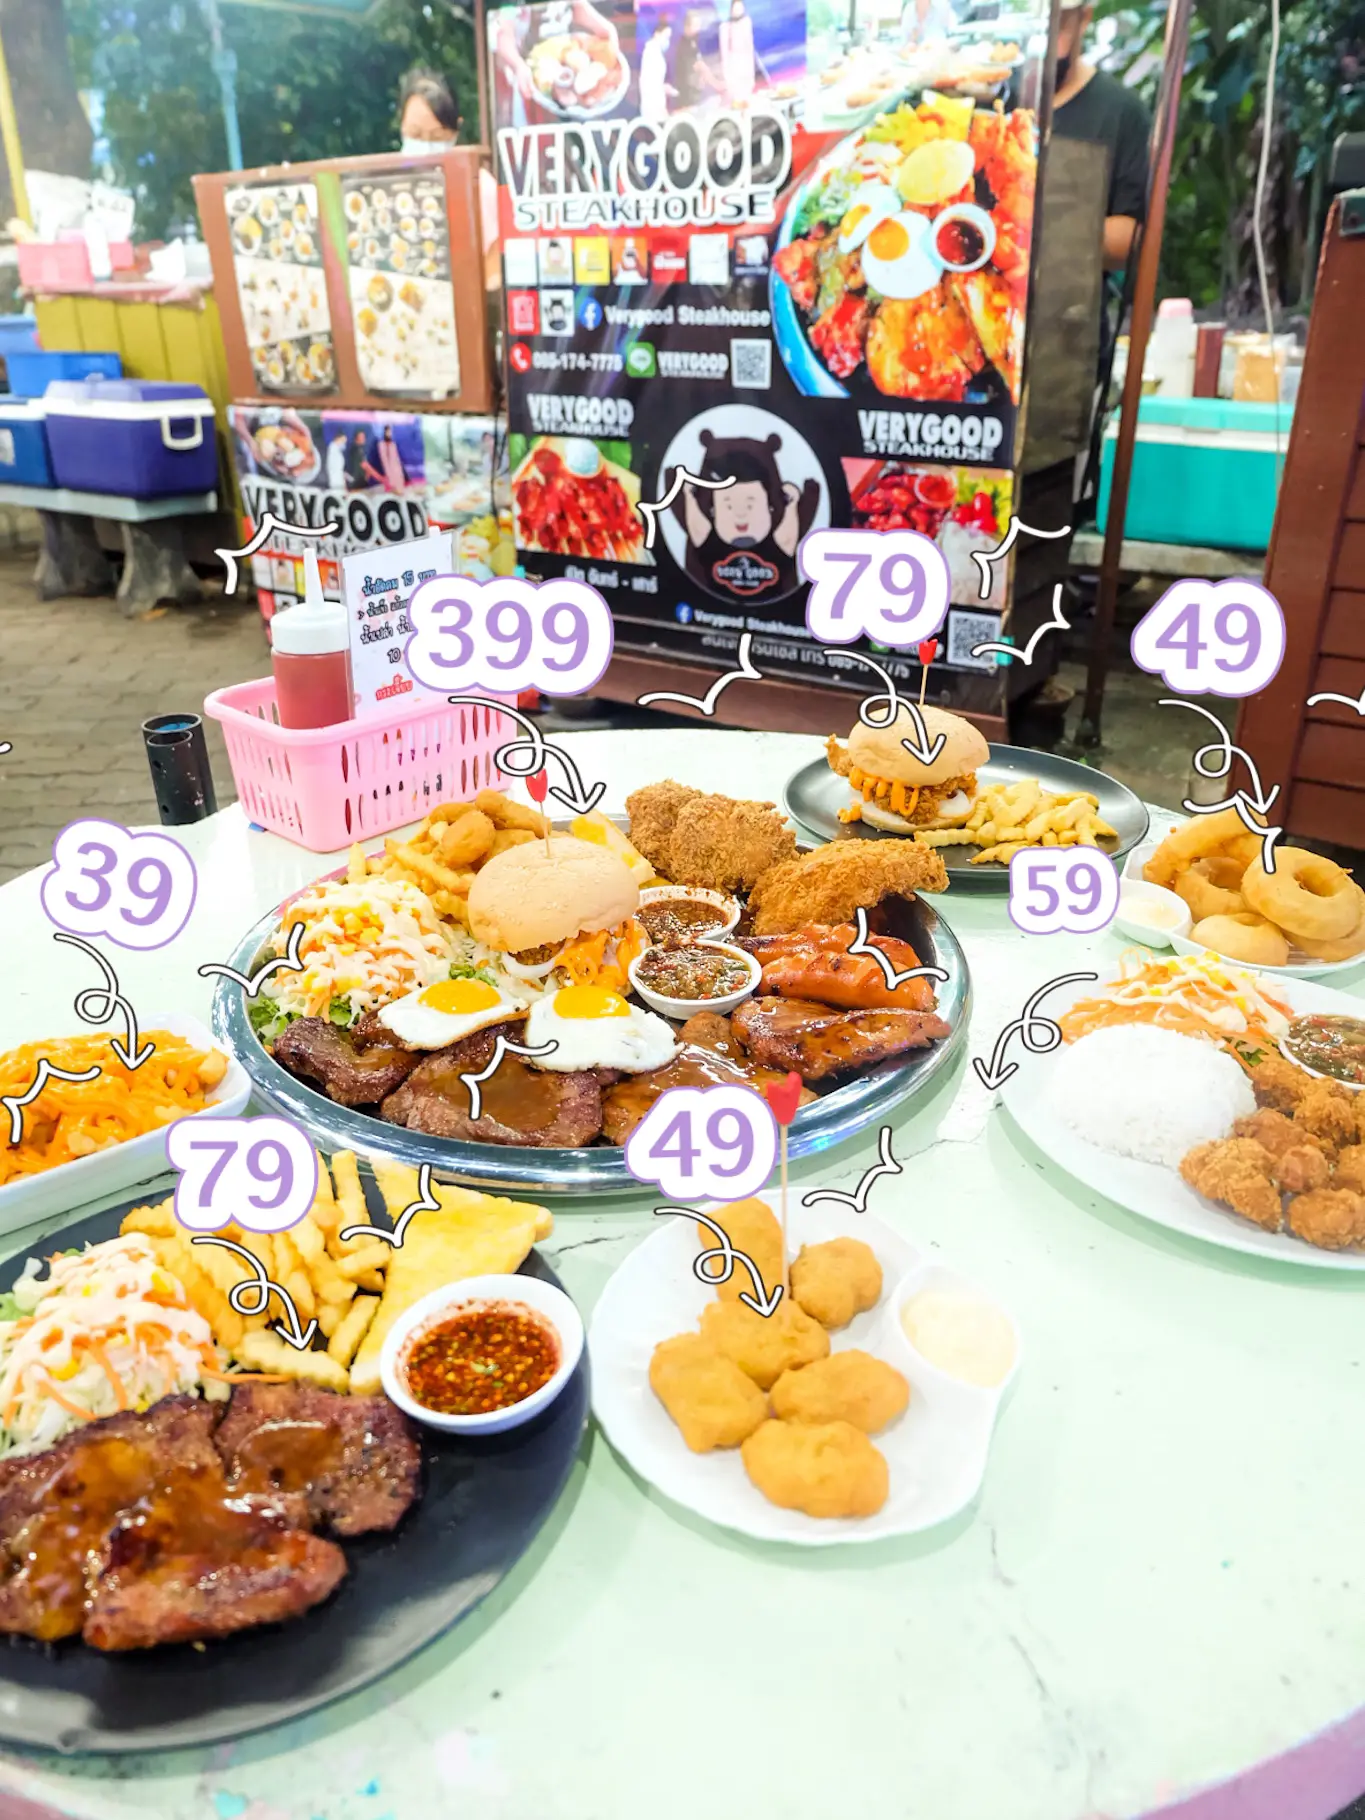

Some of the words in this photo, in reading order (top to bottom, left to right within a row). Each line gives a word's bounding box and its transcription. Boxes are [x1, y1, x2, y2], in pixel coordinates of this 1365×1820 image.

[503, 115, 788, 198] VERYGOOD
[516, 190, 774, 226] STEAKHOUSE
[605, 304, 674, 328] Verygood
[678, 304, 772, 328] Steakhouse
[526, 393, 634, 425] VERYGOOD
[858, 410, 1003, 448] VERYGOOD
[863, 440, 994, 462] STEAKHOUSE
[245, 484, 425, 542] VERYGOOD
[401, 570, 415, 587] 15
[387, 647, 402, 664] 10
